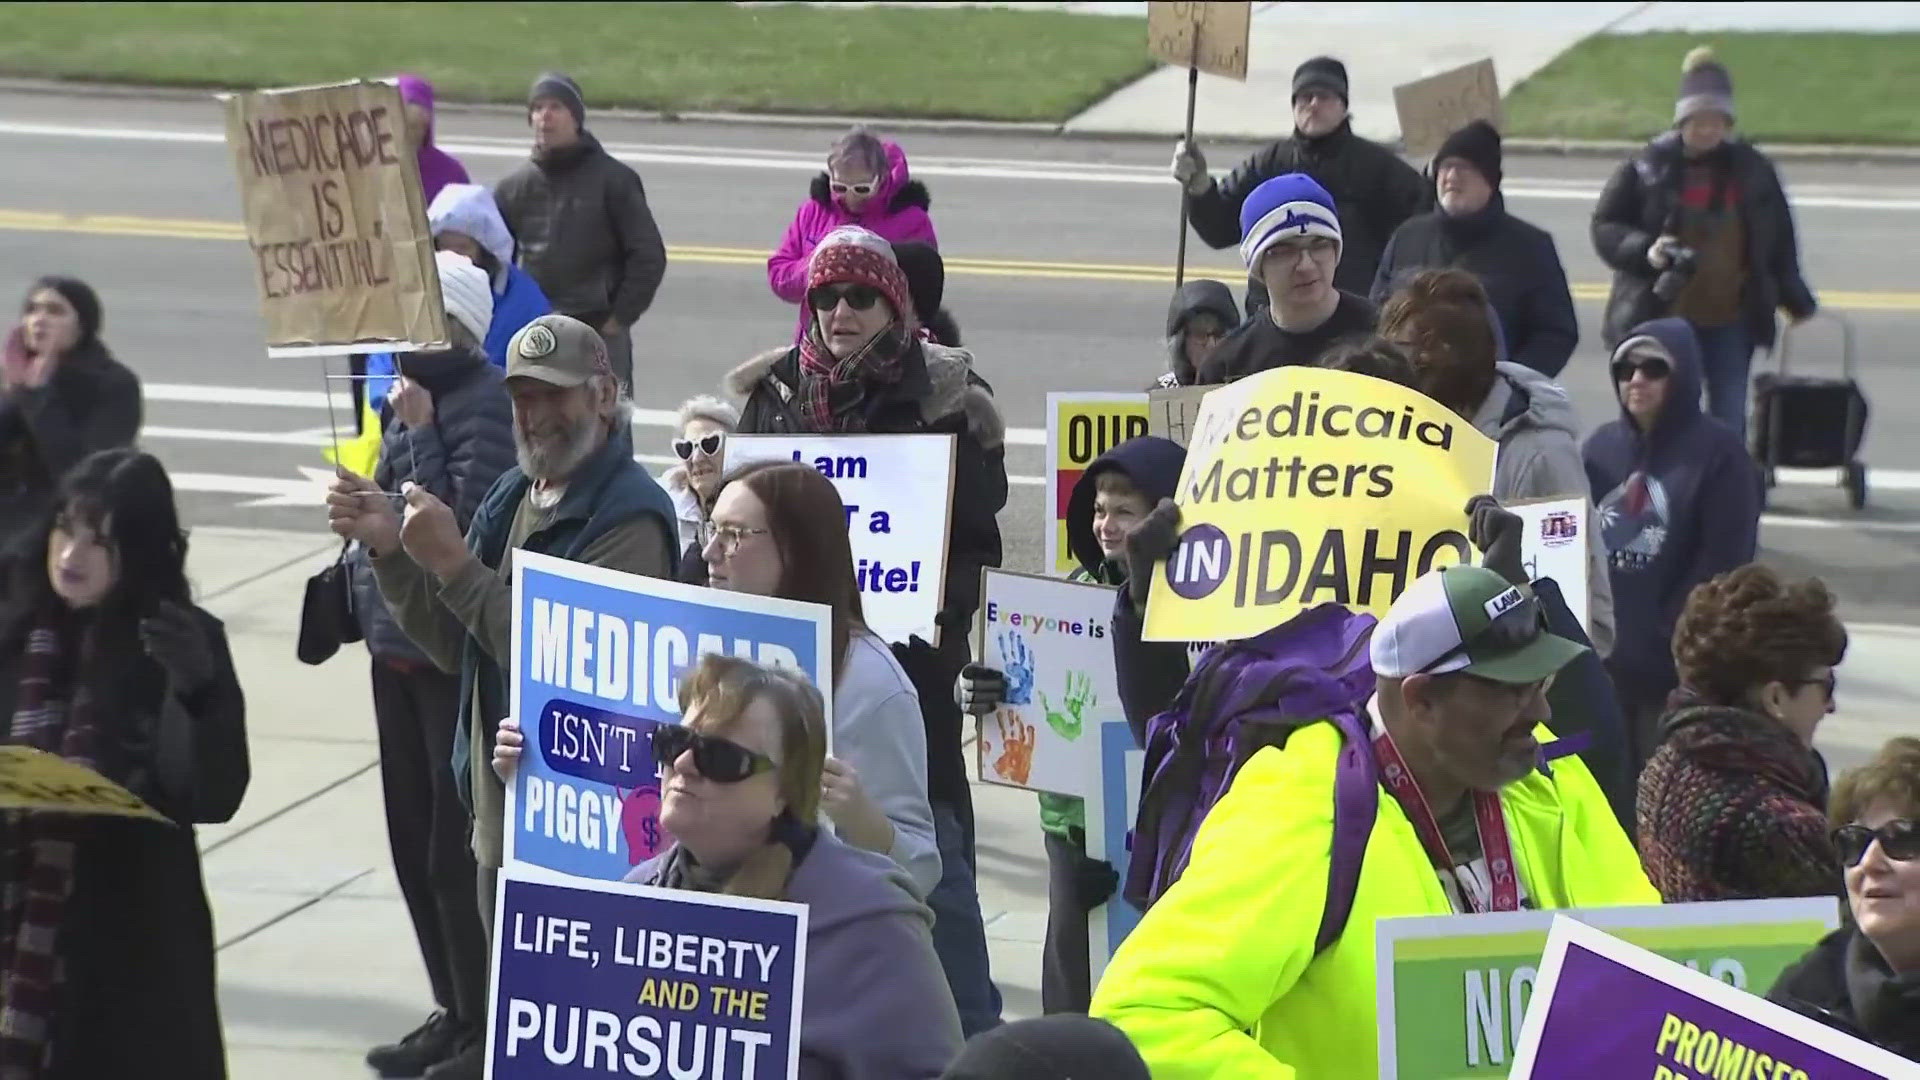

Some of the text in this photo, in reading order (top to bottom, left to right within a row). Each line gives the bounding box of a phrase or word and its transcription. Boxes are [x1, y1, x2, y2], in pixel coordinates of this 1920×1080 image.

[245, 106, 399, 177] MEDICADE
[312, 179, 344, 241] IS
[814, 456, 868, 478] am
[1182, 456, 1395, 505] Matters
[869, 510, 891, 534] a
[1174, 539, 1223, 583] IN
[987, 602, 1105, 638] Everyone is
[550, 710, 636, 773] ISN'T
[524, 775, 622, 854] PIGGY
[513, 912, 781, 983] LIFE, LIBERTY
[637, 978, 770, 1021] AND THE
[506, 997, 772, 1080] PURSUIT
[1655, 1012, 1810, 1080] PROMIS
